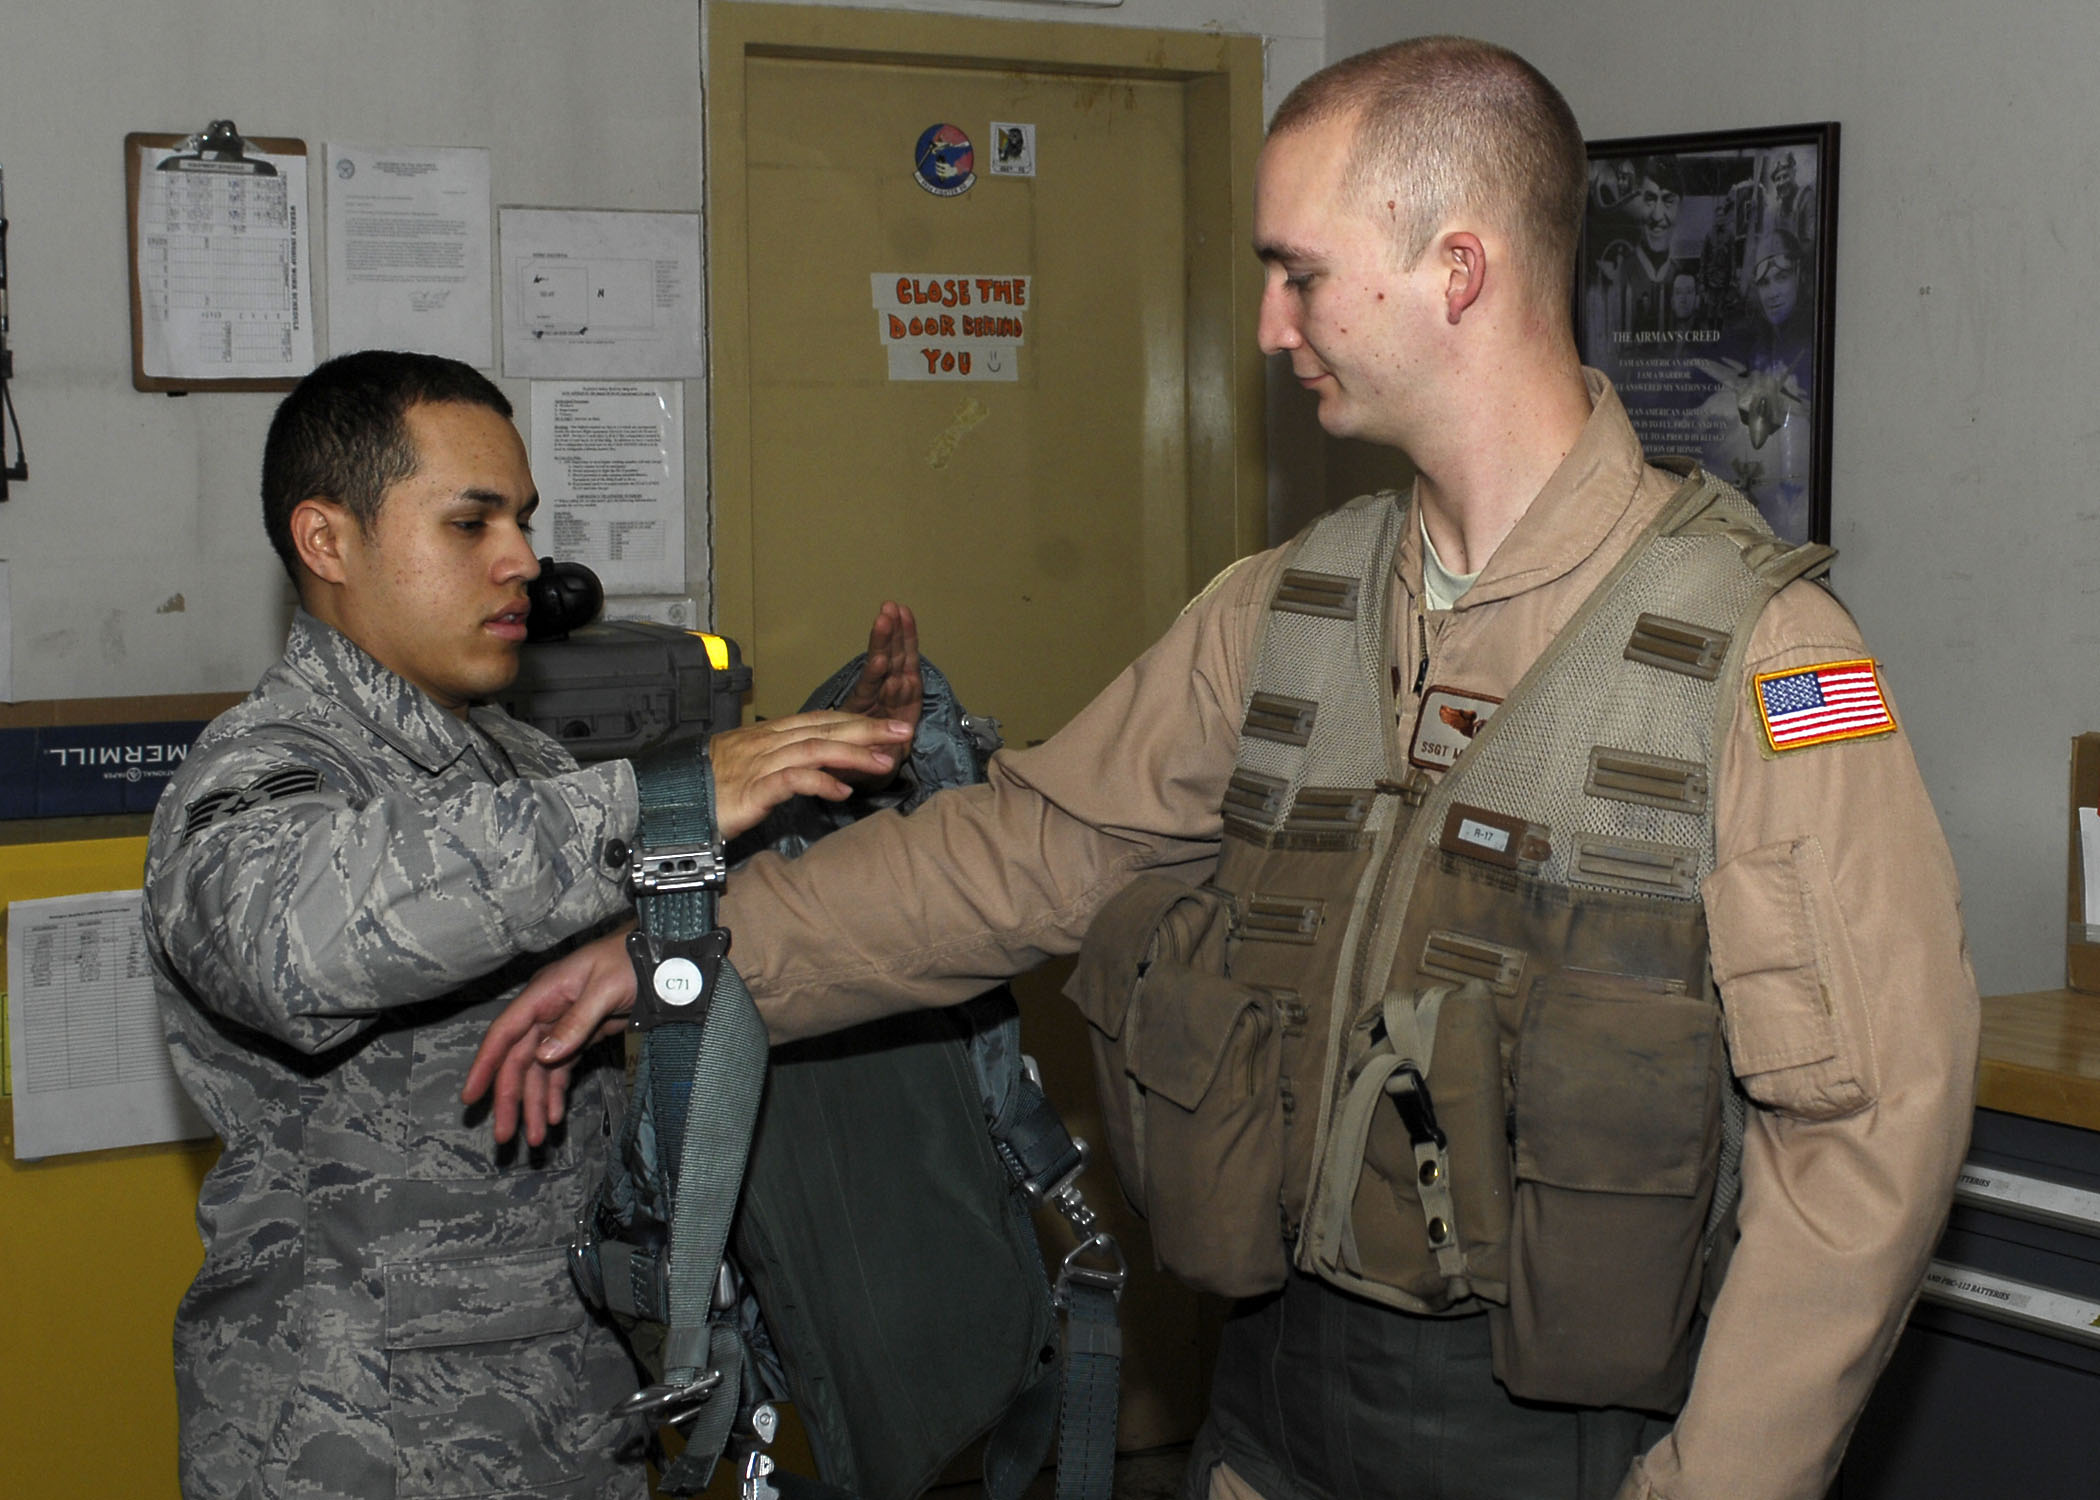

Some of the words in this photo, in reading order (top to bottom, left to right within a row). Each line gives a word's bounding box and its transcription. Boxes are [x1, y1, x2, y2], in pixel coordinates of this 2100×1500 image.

[896, 277, 971, 308] CLOSE
[975, 278, 1026, 306] THE
[887, 313, 957, 340] DOOR
[962, 314, 1023, 338] BEHIND
[1612, 331, 1632, 343] THE
[1635, 330, 1684, 343] AIRMAN'S
[1685, 330, 1721, 343] CREED
[920, 347, 972, 376] YOU
[1645, 359, 1681, 368] AMERICAN
[49, 743, 187, 766] MERMILL
[1421, 741, 1449, 757] SSGT
[665, 978, 689, 991] C71
[1959, 1175, 1991, 1188] TTERIES
[1970, 1283, 2011, 1301] BATTERIES
